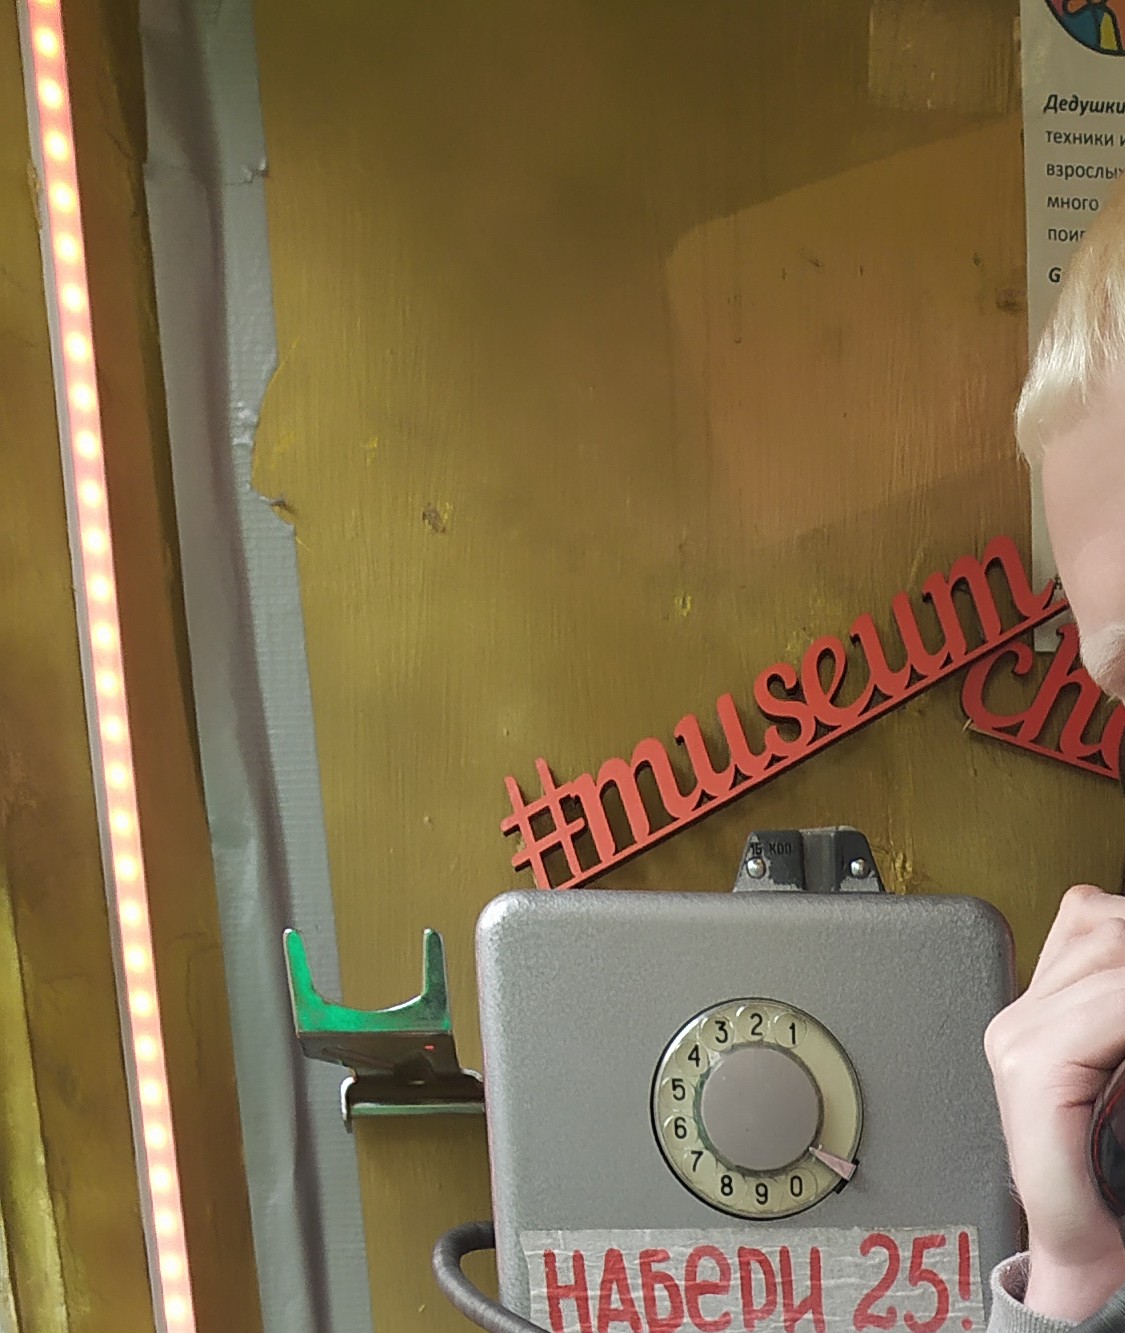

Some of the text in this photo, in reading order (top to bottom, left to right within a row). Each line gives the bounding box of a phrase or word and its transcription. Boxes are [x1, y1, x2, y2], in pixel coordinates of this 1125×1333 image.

[1046, 130, 1114, 147] техники
[1047, 196, 1099, 211] много
[500, 534, 1056, 890] #museum
[671, 1013, 803, 1205] 1 2 3 4 5 6 7 8 9 0
